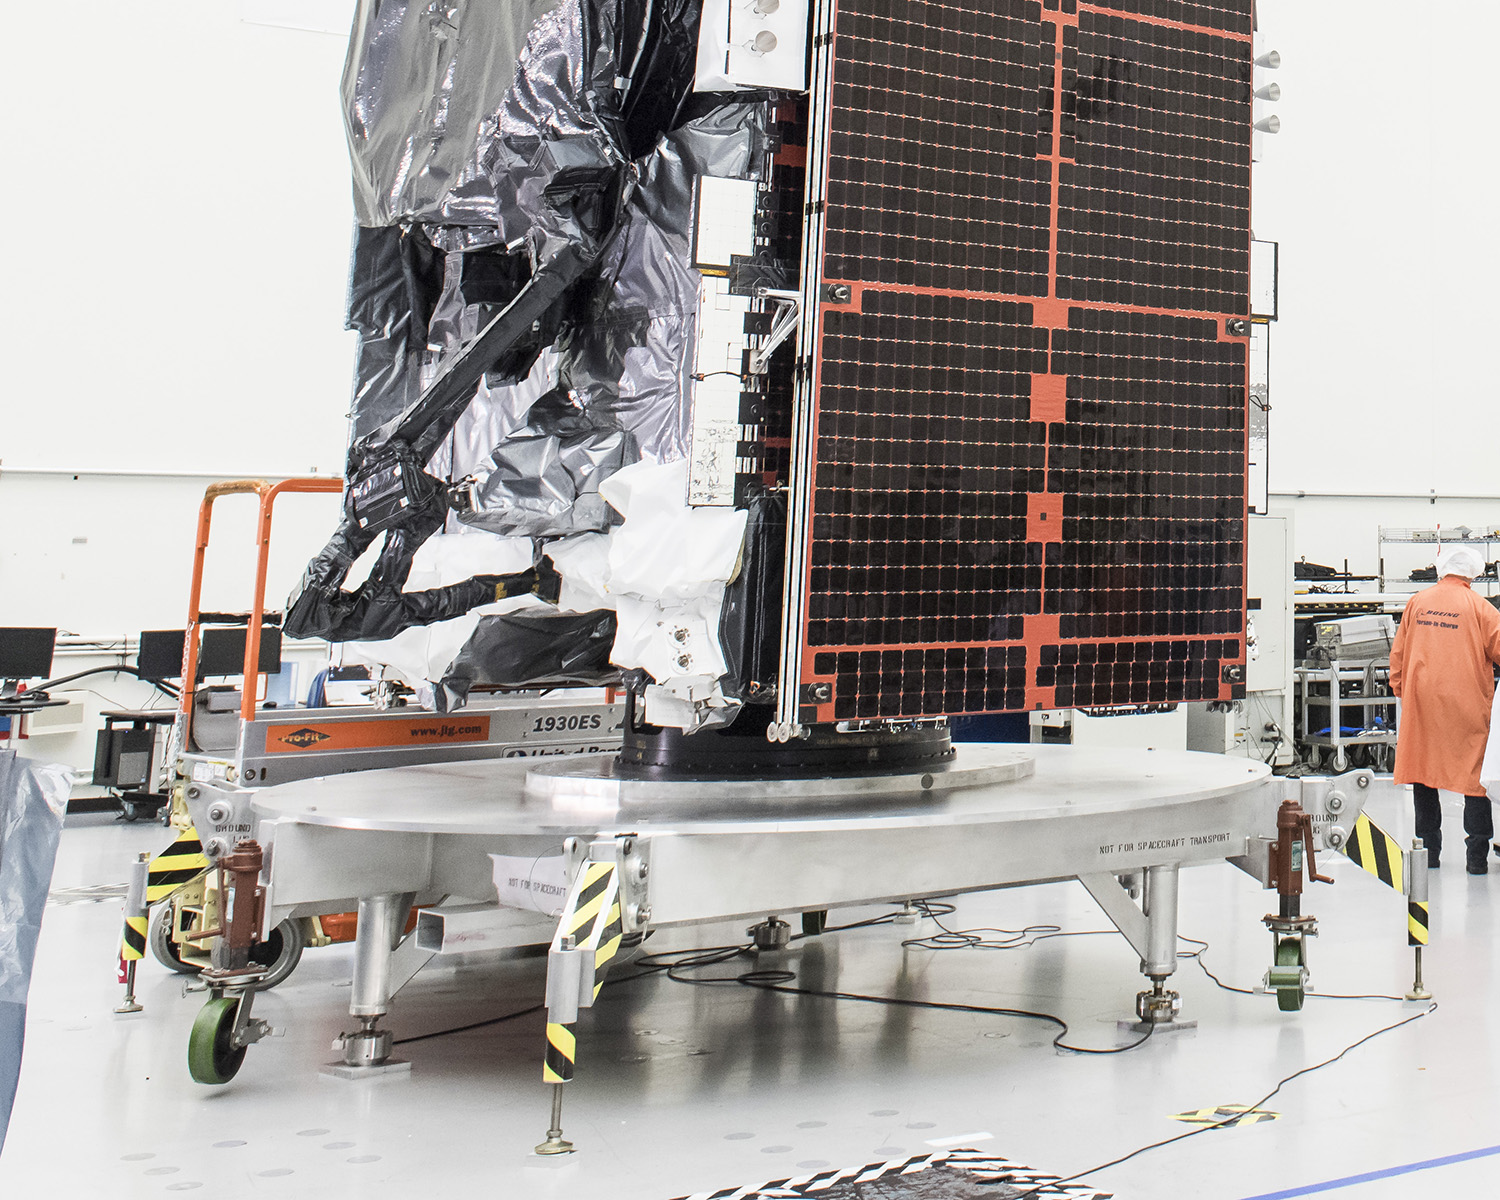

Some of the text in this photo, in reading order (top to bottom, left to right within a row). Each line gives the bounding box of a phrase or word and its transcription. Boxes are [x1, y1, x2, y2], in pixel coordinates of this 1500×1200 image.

[1426, 610, 1460, 618] BOEING
[533, 714, 602, 733] 1930ES
[410, 725, 482, 737] www.jlg.com
[282, 732, 321, 743] Pro-Fit
[1311, 814, 1338, 822] ROUND
[215, 824, 251, 833] GROUND
[1099, 832, 1231, 855] NOT FOR SPACECRAFT TRANSPORT
[508, 878, 567, 897] NOT FOR SPACECRAFT
